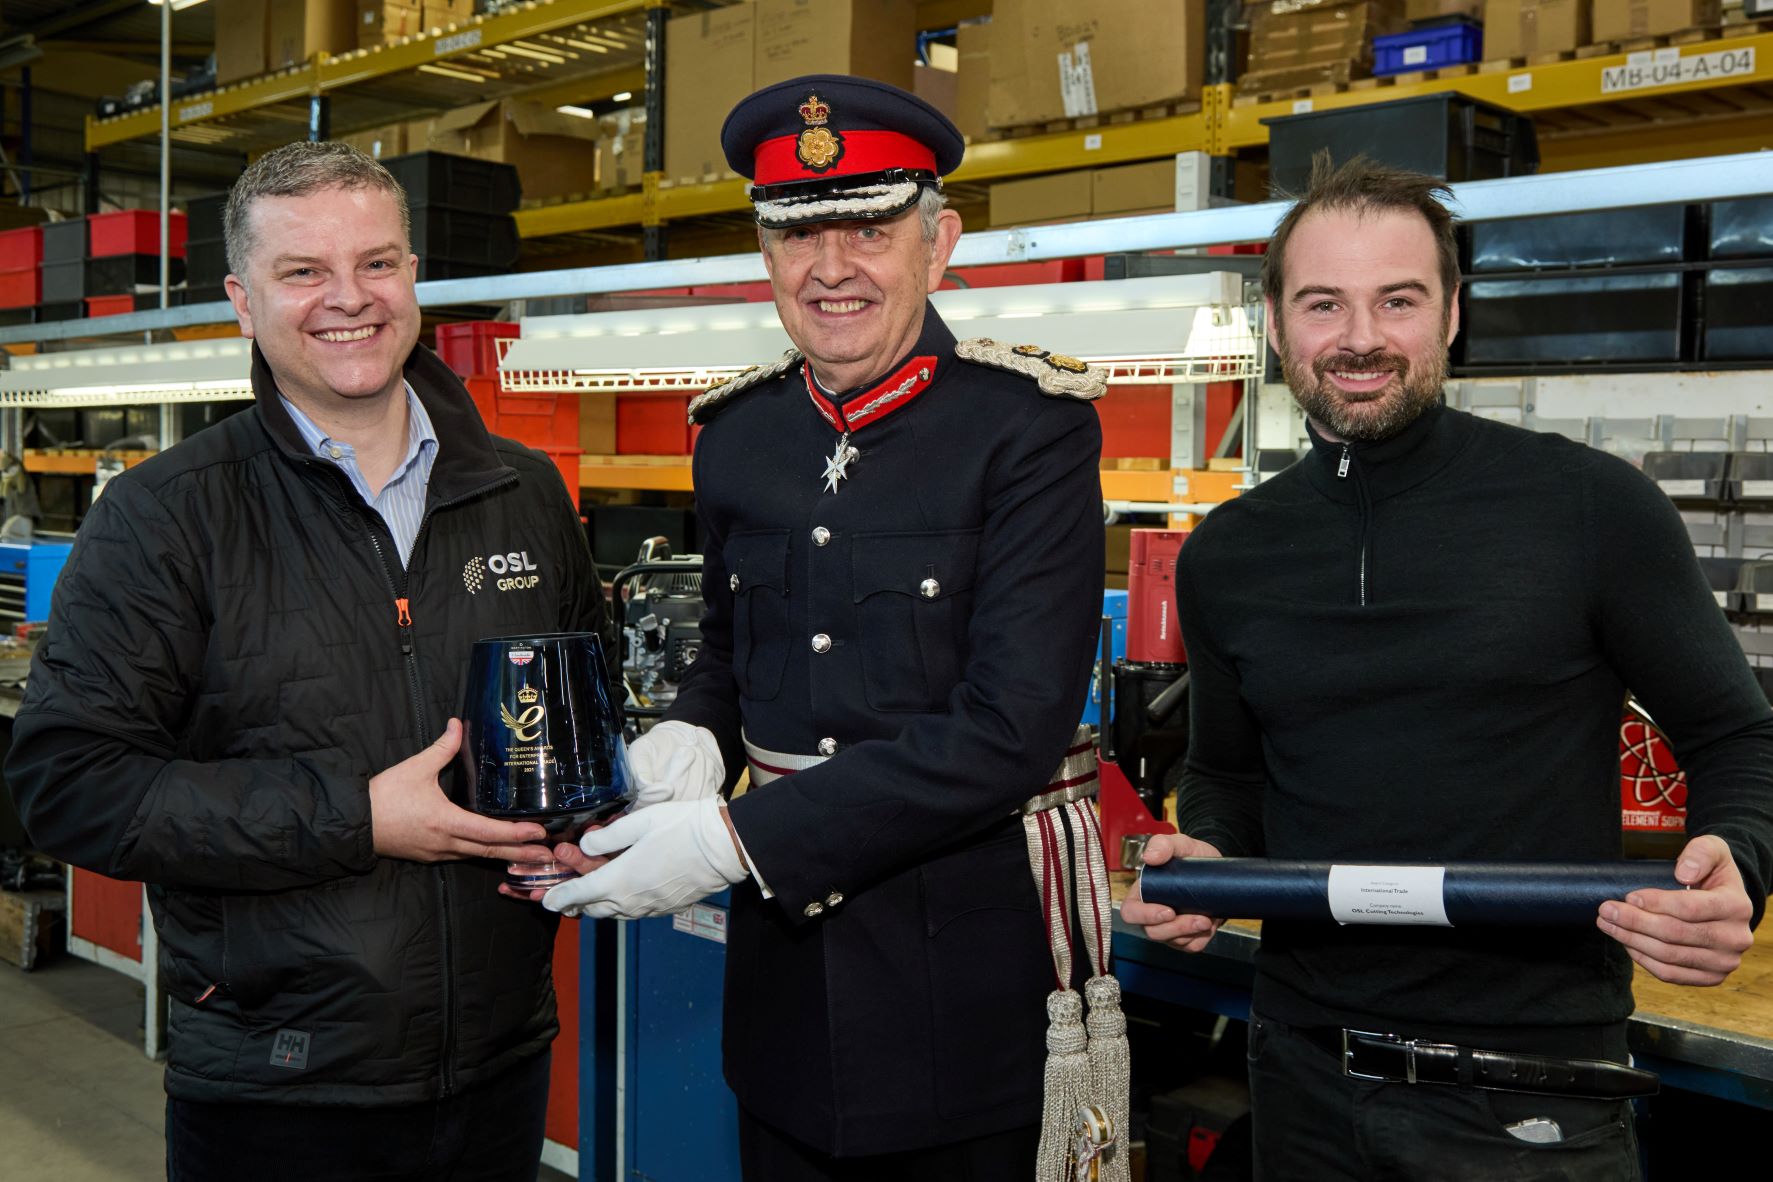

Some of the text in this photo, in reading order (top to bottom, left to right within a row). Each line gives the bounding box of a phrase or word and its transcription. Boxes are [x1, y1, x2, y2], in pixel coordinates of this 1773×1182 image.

[1603, 51, 1750, 90] MB-04-A-04
[488, 551, 537, 574] OSL
[497, 575, 539, 591] GROUP
